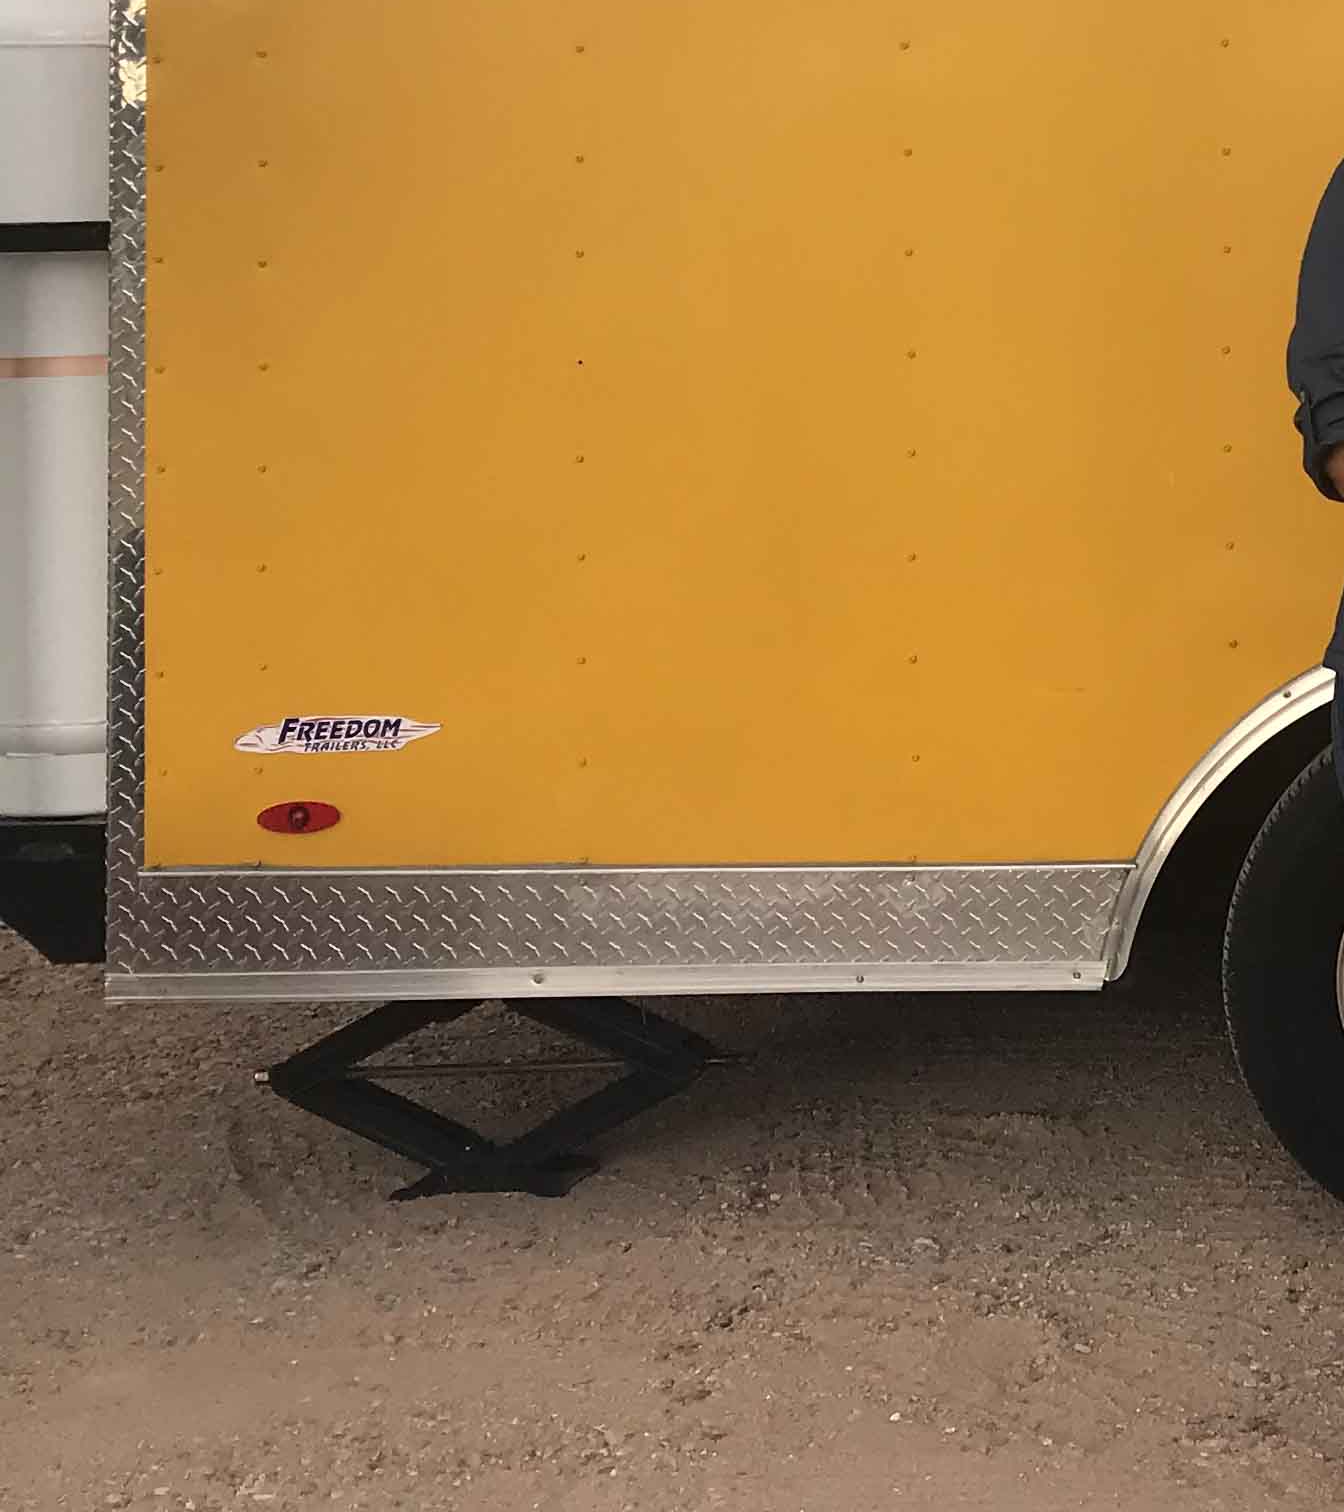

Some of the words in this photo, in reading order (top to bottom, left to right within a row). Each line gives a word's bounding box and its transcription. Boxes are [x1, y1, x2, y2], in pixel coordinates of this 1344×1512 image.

[278, 718, 402, 744] FREEDOM
[304, 740, 370, 753] TRAILERS,
[377, 738, 400, 749] LLC
